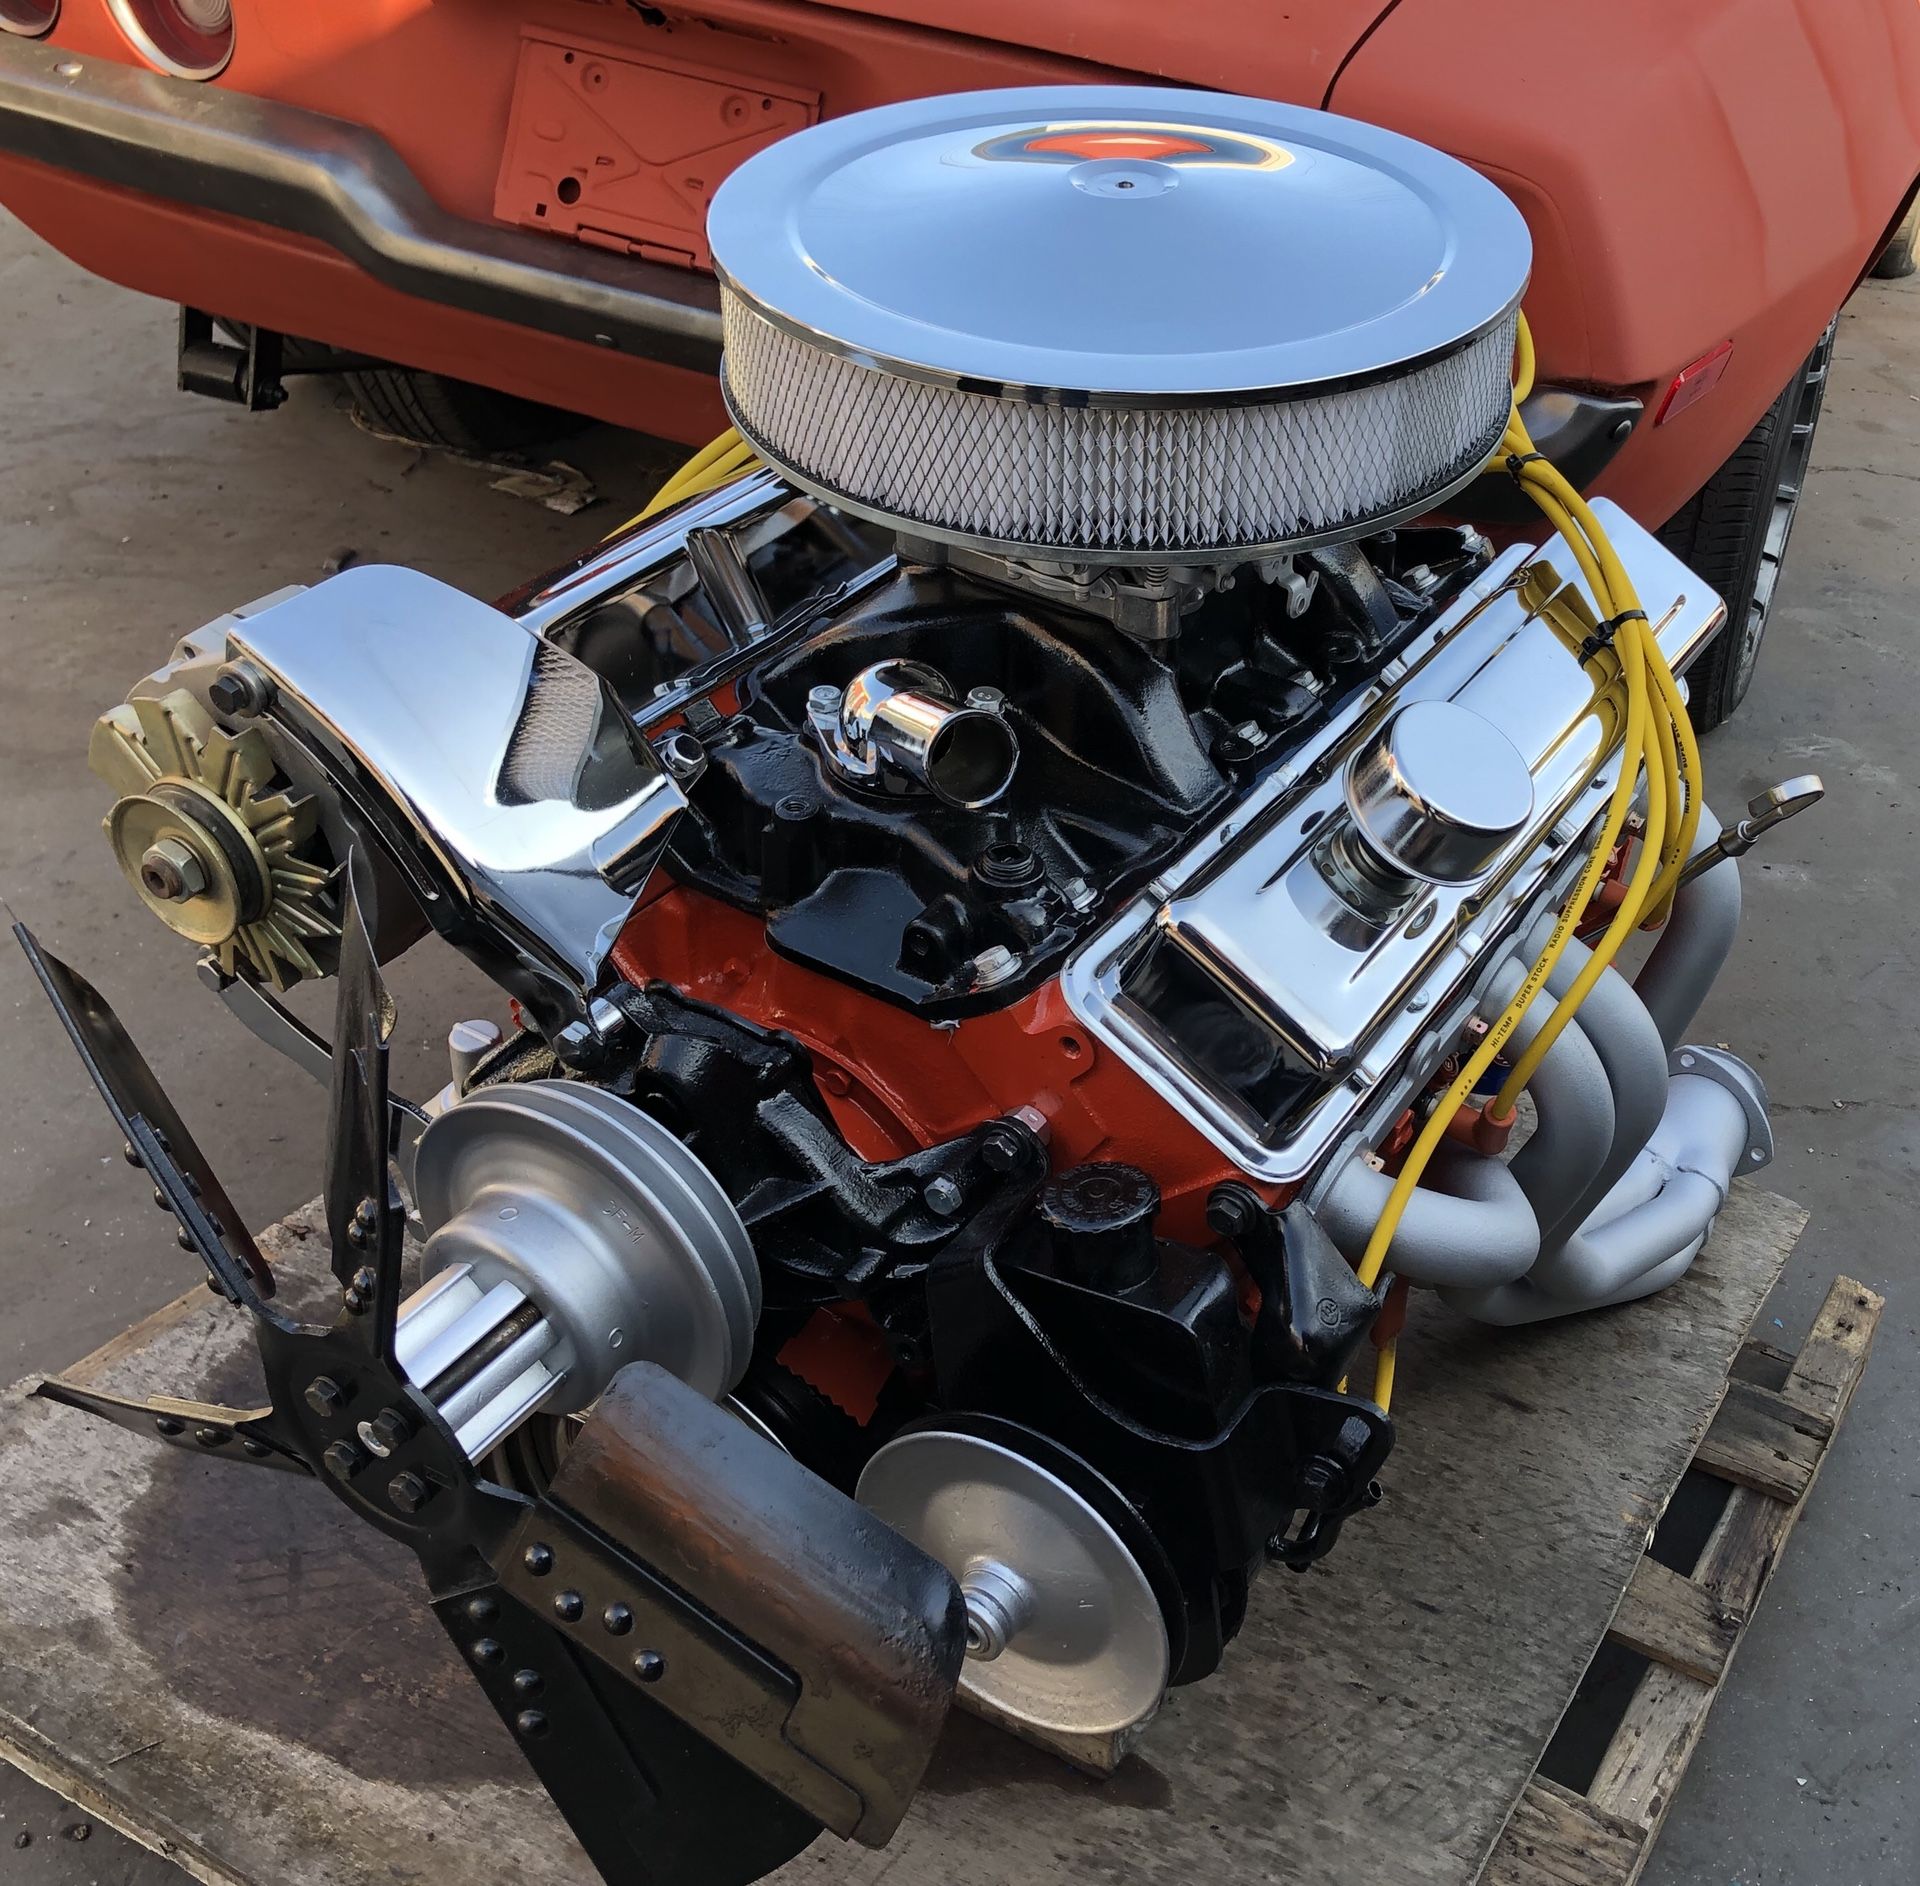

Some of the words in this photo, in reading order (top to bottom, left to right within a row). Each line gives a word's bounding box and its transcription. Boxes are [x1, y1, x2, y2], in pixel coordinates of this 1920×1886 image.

[1678, 741, 1688, 769] SUPER
[1491, 1016, 1513, 1048] HI-TEMP
[1515, 984, 1534, 1009] SUPER
[1531, 956, 1549, 983] STOCK
[1549, 925, 1565, 949] RADIO
[1561, 876, 1588, 923] SUPPRESSION
